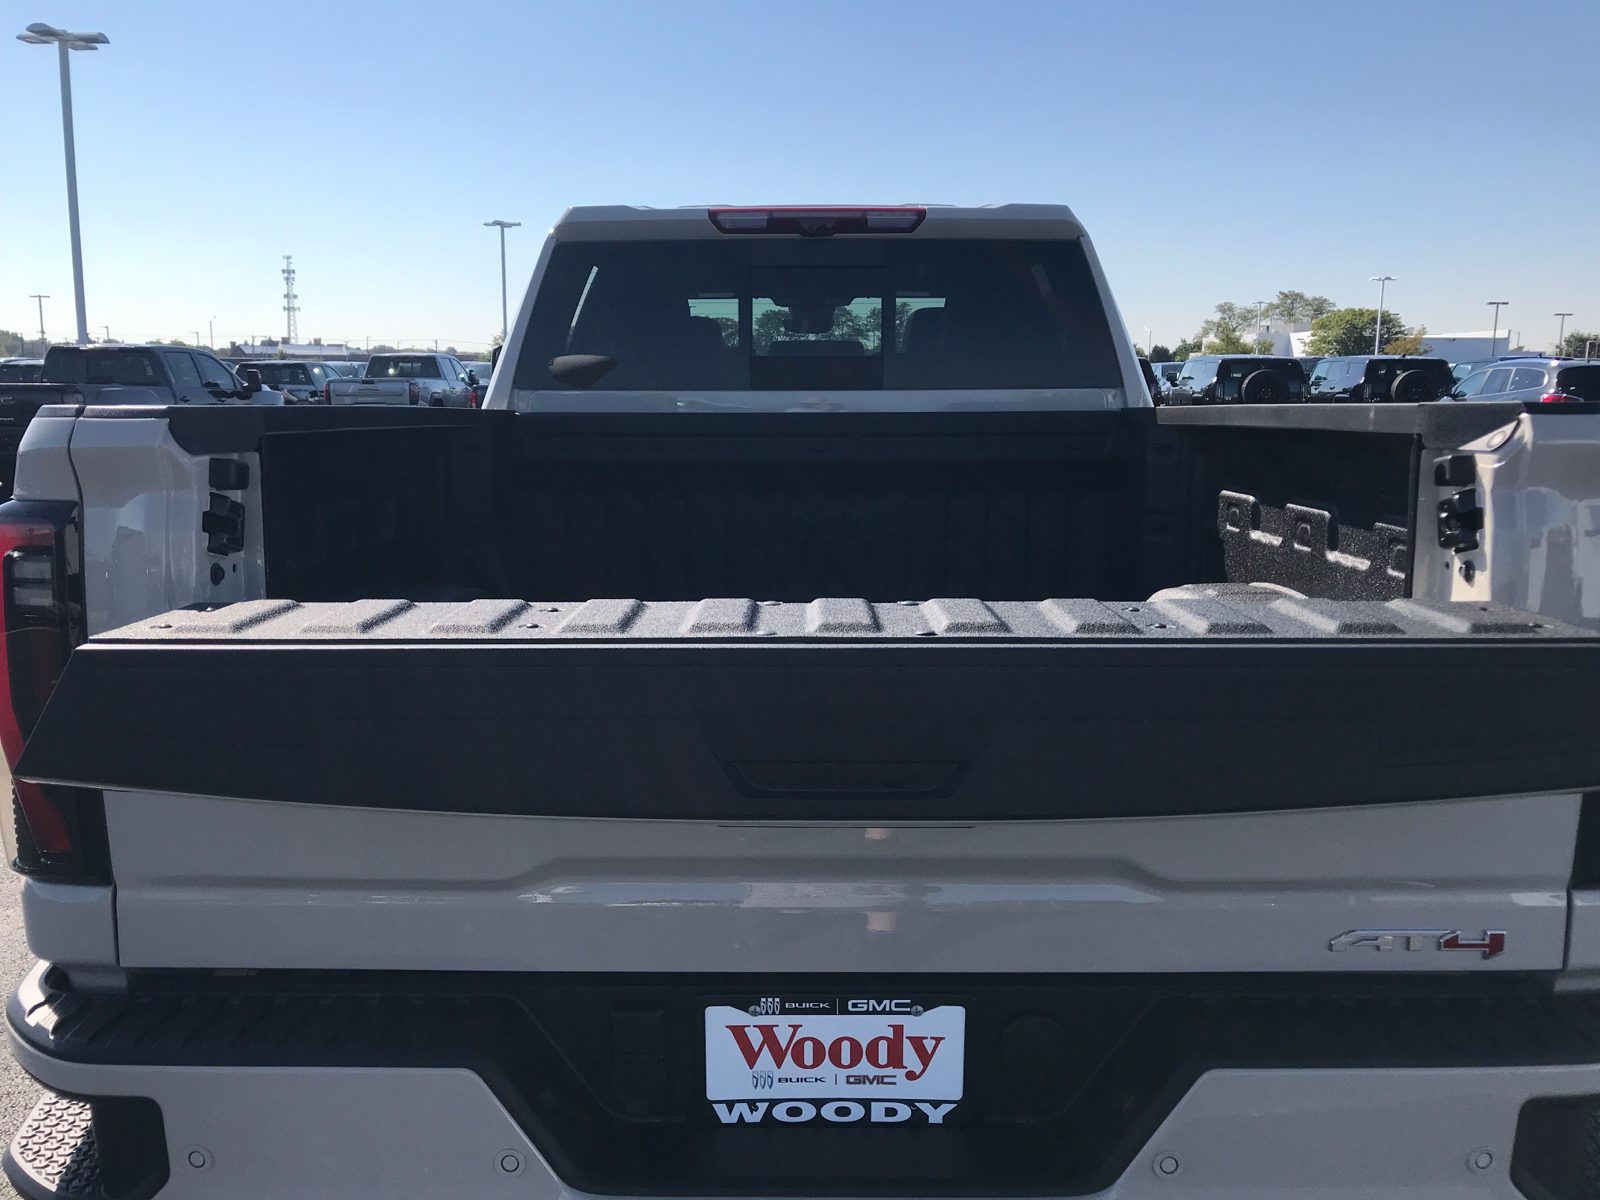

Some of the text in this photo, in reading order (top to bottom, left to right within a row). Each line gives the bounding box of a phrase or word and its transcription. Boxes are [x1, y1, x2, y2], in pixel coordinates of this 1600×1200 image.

[785, 999, 912, 1012] BUICK GMC
[725, 1024, 946, 1082] Woody
[777, 1074, 897, 1086] BUICK GMC
[711, 1101, 958, 1124] WOODY
